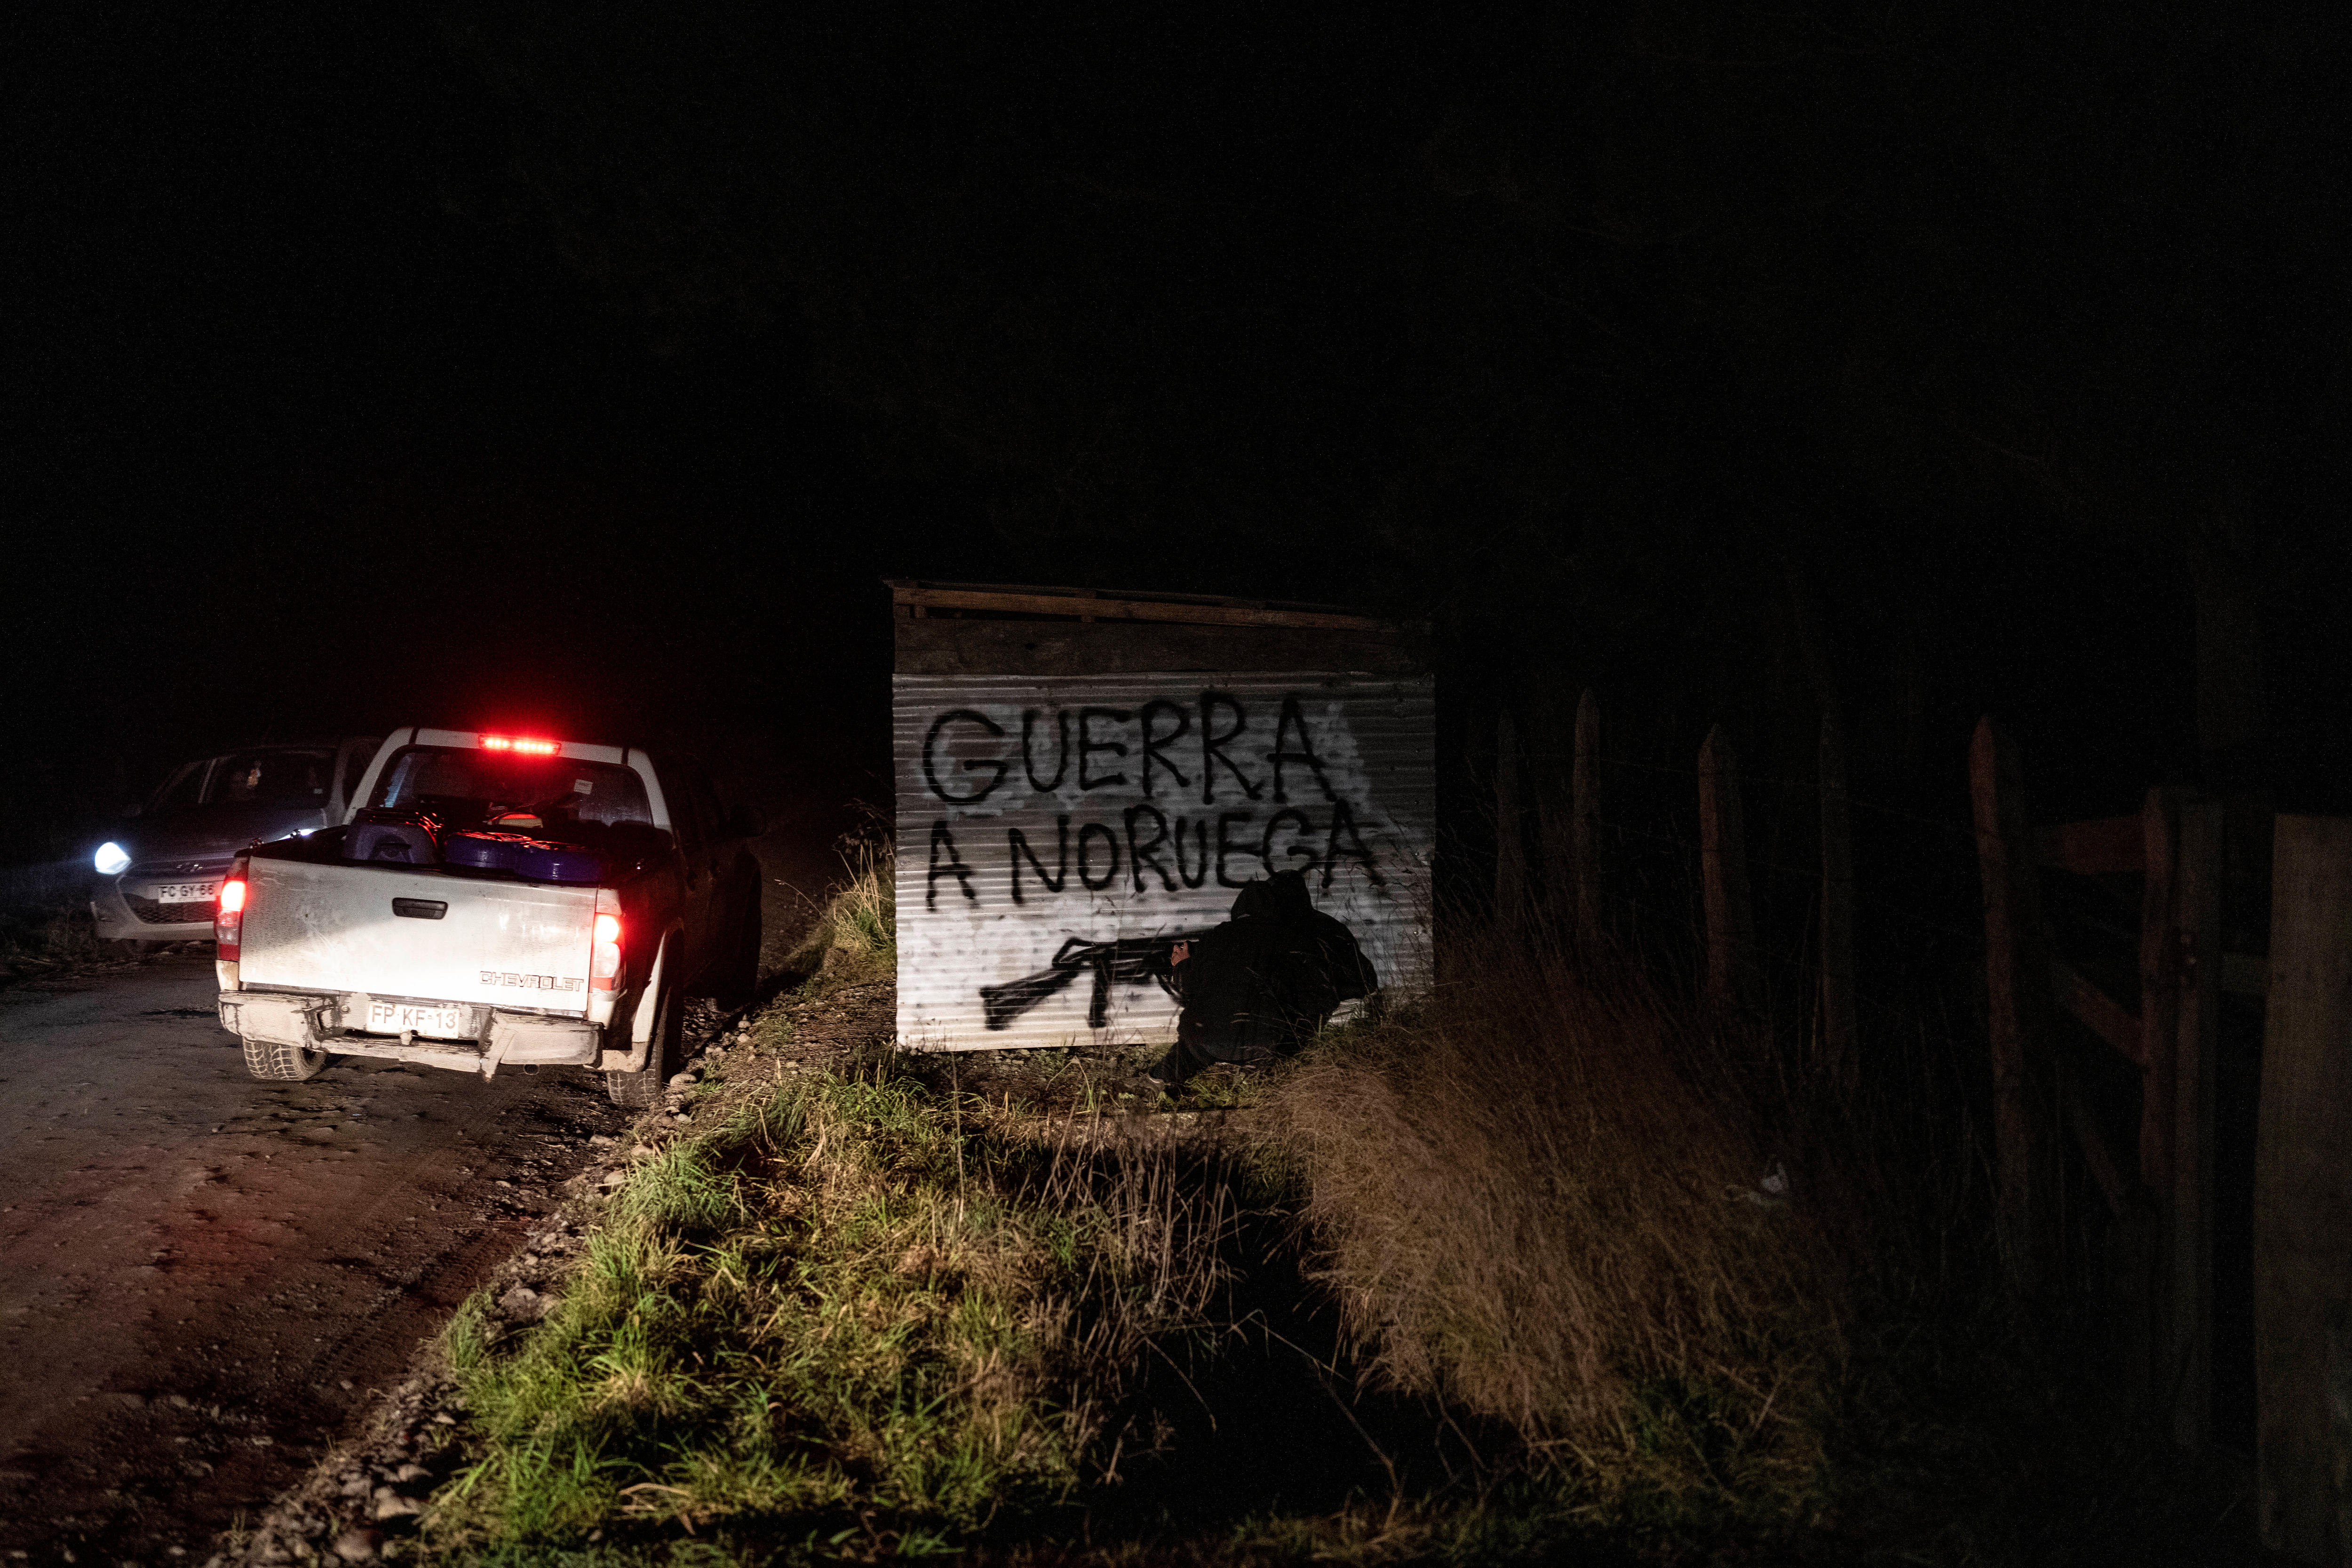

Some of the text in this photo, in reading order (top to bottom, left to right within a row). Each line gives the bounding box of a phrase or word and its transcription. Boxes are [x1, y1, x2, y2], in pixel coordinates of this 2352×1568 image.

[922, 691, 1341, 805] GUERRA
[926, 797, 1384, 912] A NORUEGA
[479, 971, 584, 992] CHEVROLET
